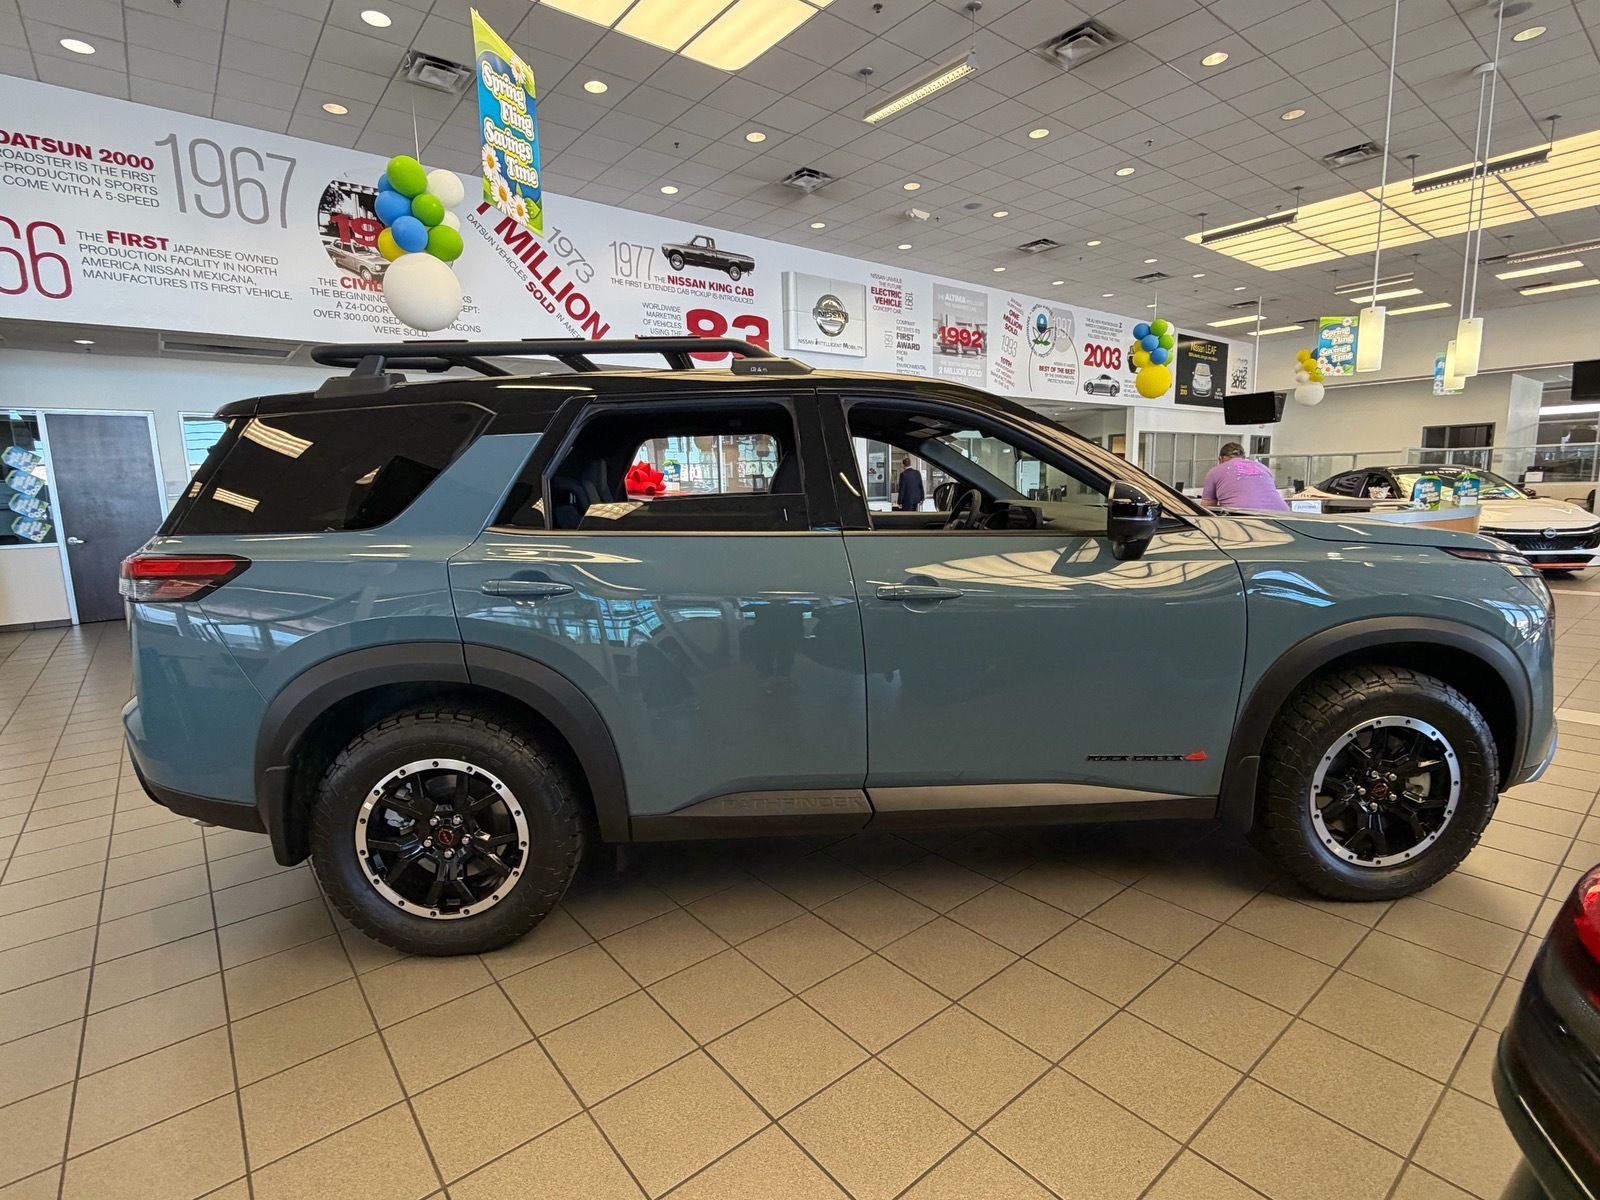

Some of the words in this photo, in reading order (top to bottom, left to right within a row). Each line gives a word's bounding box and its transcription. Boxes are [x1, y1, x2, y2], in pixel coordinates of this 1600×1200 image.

[483, 62, 525, 110] Spring
[501, 101, 533, 139] Fling
[0, 129, 93, 160] DATSUN
[98, 148, 154, 171] 2000
[484, 119, 532, 162] Savings
[75, 161, 88, 172] IS
[91, 163, 118, 177] THE
[121, 169, 156, 183] FIRST
[155, 133, 297, 229] 1967
[506, 157, 538, 187] Time
[2, 175, 49, 191] COME
[52, 182, 89, 197] WITH
[93, 189, 102, 199] A
[105, 191, 160, 208] 5-SPEED
[104, 178, 158, 196] SPORTS
[330, 212, 382, 248] 19
[0, 215, 73, 299] 66
[76, 230, 103, 243] THE
[106, 230, 169, 251] FIRST
[173, 243, 232, 260] JAPANESE
[235, 251, 279, 266] OWNED
[547, 226, 595, 284] 1973
[79, 243, 167, 263] PRODUCTION
[170, 254, 220, 269] FACILITY
[223, 261, 235, 271] IN
[238, 264, 278, 277] NORTH
[81, 256, 141, 272] AMERICA
[144, 263, 190, 278] NISSAN
[193, 269, 257, 286] MEXICANA,
[466, 213, 497, 246] DATSUN
[495, 243, 528, 281] VEHICLES
[525, 281, 556, 315] SOLD
[556, 312, 565, 323] IN
[608, 241, 655, 280] 1977
[83, 268, 188, 289] MANUFACTURES
[190, 280, 208, 291] ITS
[211, 282, 243, 294] FIRST
[318, 277, 338, 288] THE
[494, 215, 611, 340] MILLION
[654, 275, 666, 284] THE
[667, 275, 706, 290] NISSAN
[709, 281, 732, 294] KING
[735, 286, 754, 297] CAB
[310, 287, 330, 298] THE
[611, 277, 623, 286] THE
[625, 279, 642, 289] FIRST
[644, 283, 676, 293] EXTENDED
[677, 287, 689, 295] CAB
[690, 290, 711, 298] PICKUP
[719, 294, 754, 304] INTRODUCED
[871, 286, 902, 299] ELECTRIC
[336, 301, 343, 310] A
[642, 302, 681, 313] WORLDWIDE
[874, 296, 902, 308] VEHICLE
[313, 308, 341, 320] OVER
[642, 318, 651, 326] OF
[653, 320, 682, 329] VEHICLES
[646, 310, 681, 321] MARKETING
[1003, 314, 1024, 331] MILLION
[1009, 309, 1020, 321] ONE
[373, 326, 401, 336] WERE
[403, 328, 430, 338] SOLD.
[650, 327, 670, 336] USING
[896, 332, 914, 342] FIRST
[938, 325, 983, 349] 1992
[896, 342, 920, 351] AWARD
[1002, 334, 1018, 357] 1993
[1083, 343, 1122, 370] 2003
[1205, 344, 1217, 355] LEAF
[1039, 365, 1050, 373] BEST
[1050, 365, 1057, 373] OF
[1065, 367, 1076, 375] BEST
[1230, 378, 1247, 390] 2012
